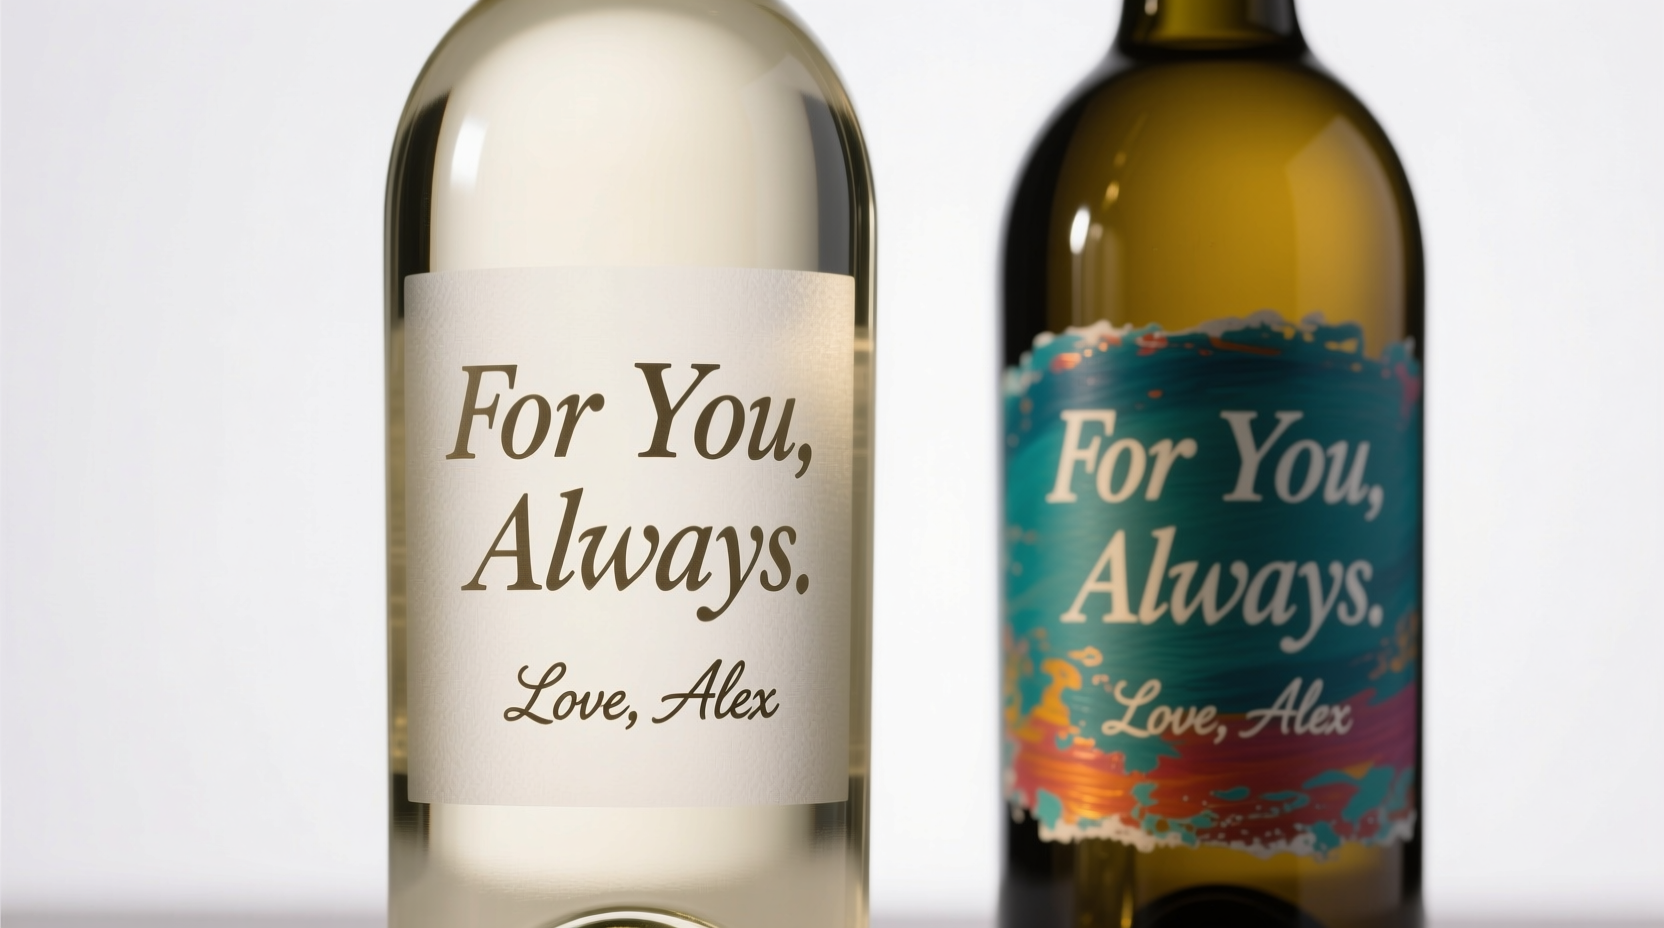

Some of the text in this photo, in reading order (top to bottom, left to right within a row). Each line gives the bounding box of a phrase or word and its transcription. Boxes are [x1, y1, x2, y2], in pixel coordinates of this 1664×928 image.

[446, 362, 812, 479] For You,
[1045, 408, 1384, 521] For You,
[461, 487, 809, 622] Always.
[1060, 525, 1383, 653] Always.
[503, 658, 779, 730] Love, Alex
[1101, 677, 1354, 744] Love, Alex
